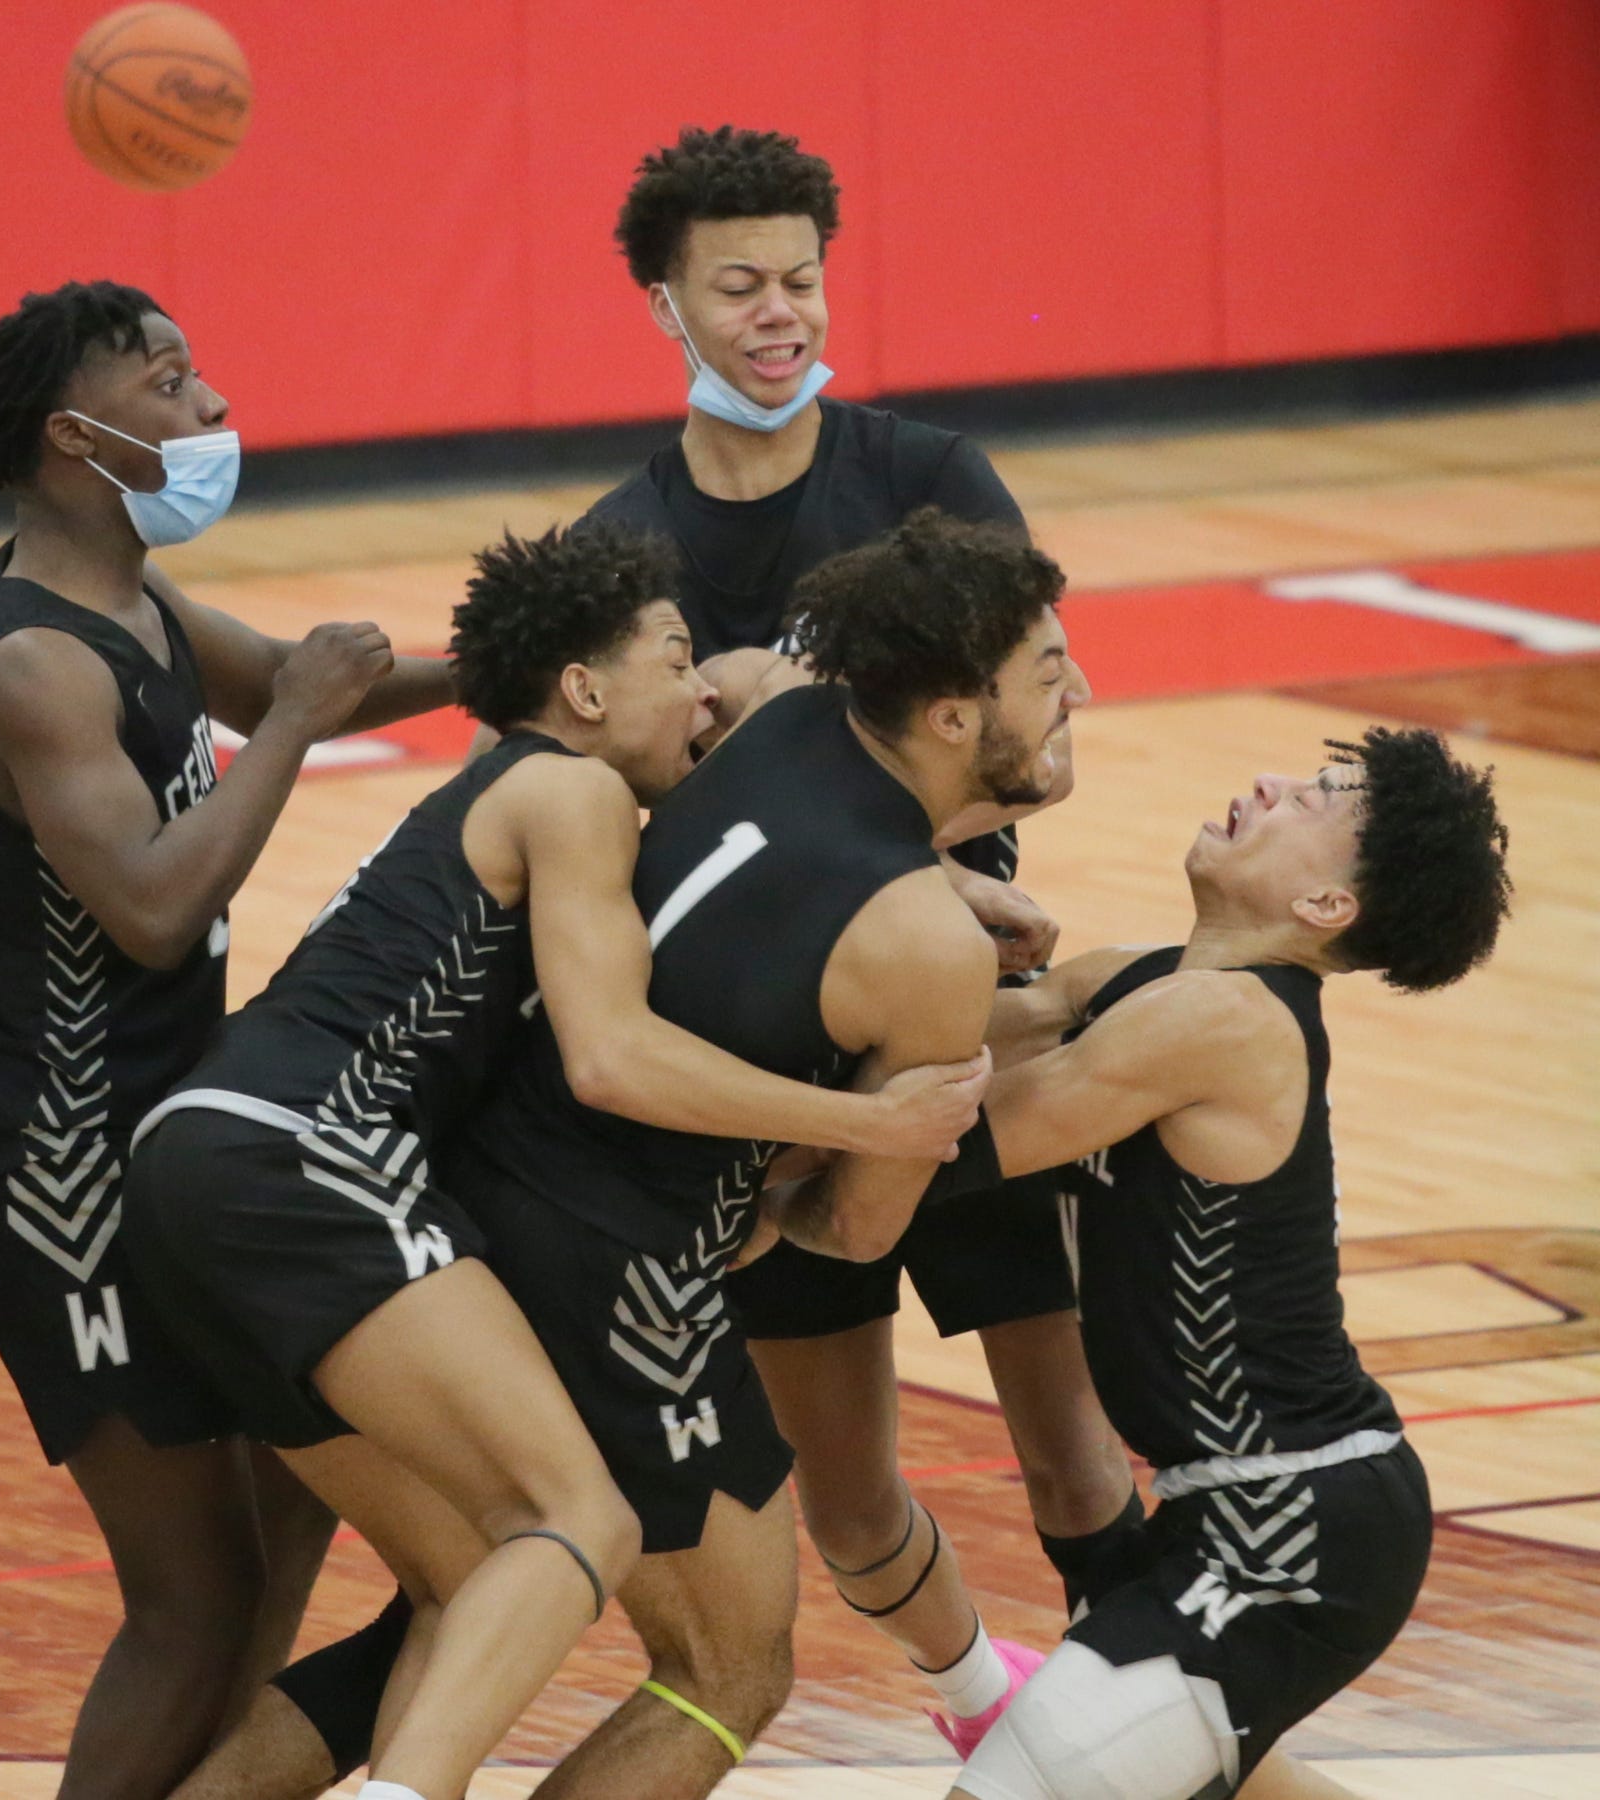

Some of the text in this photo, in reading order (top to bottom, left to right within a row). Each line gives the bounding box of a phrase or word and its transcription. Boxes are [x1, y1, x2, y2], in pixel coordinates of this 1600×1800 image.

[647, 820, 769, 956] 1
[385, 1217, 456, 1281] W
[64, 1284, 131, 1373] W
[658, 1394, 722, 1463] W
[1173, 1570, 1253, 1641] W
